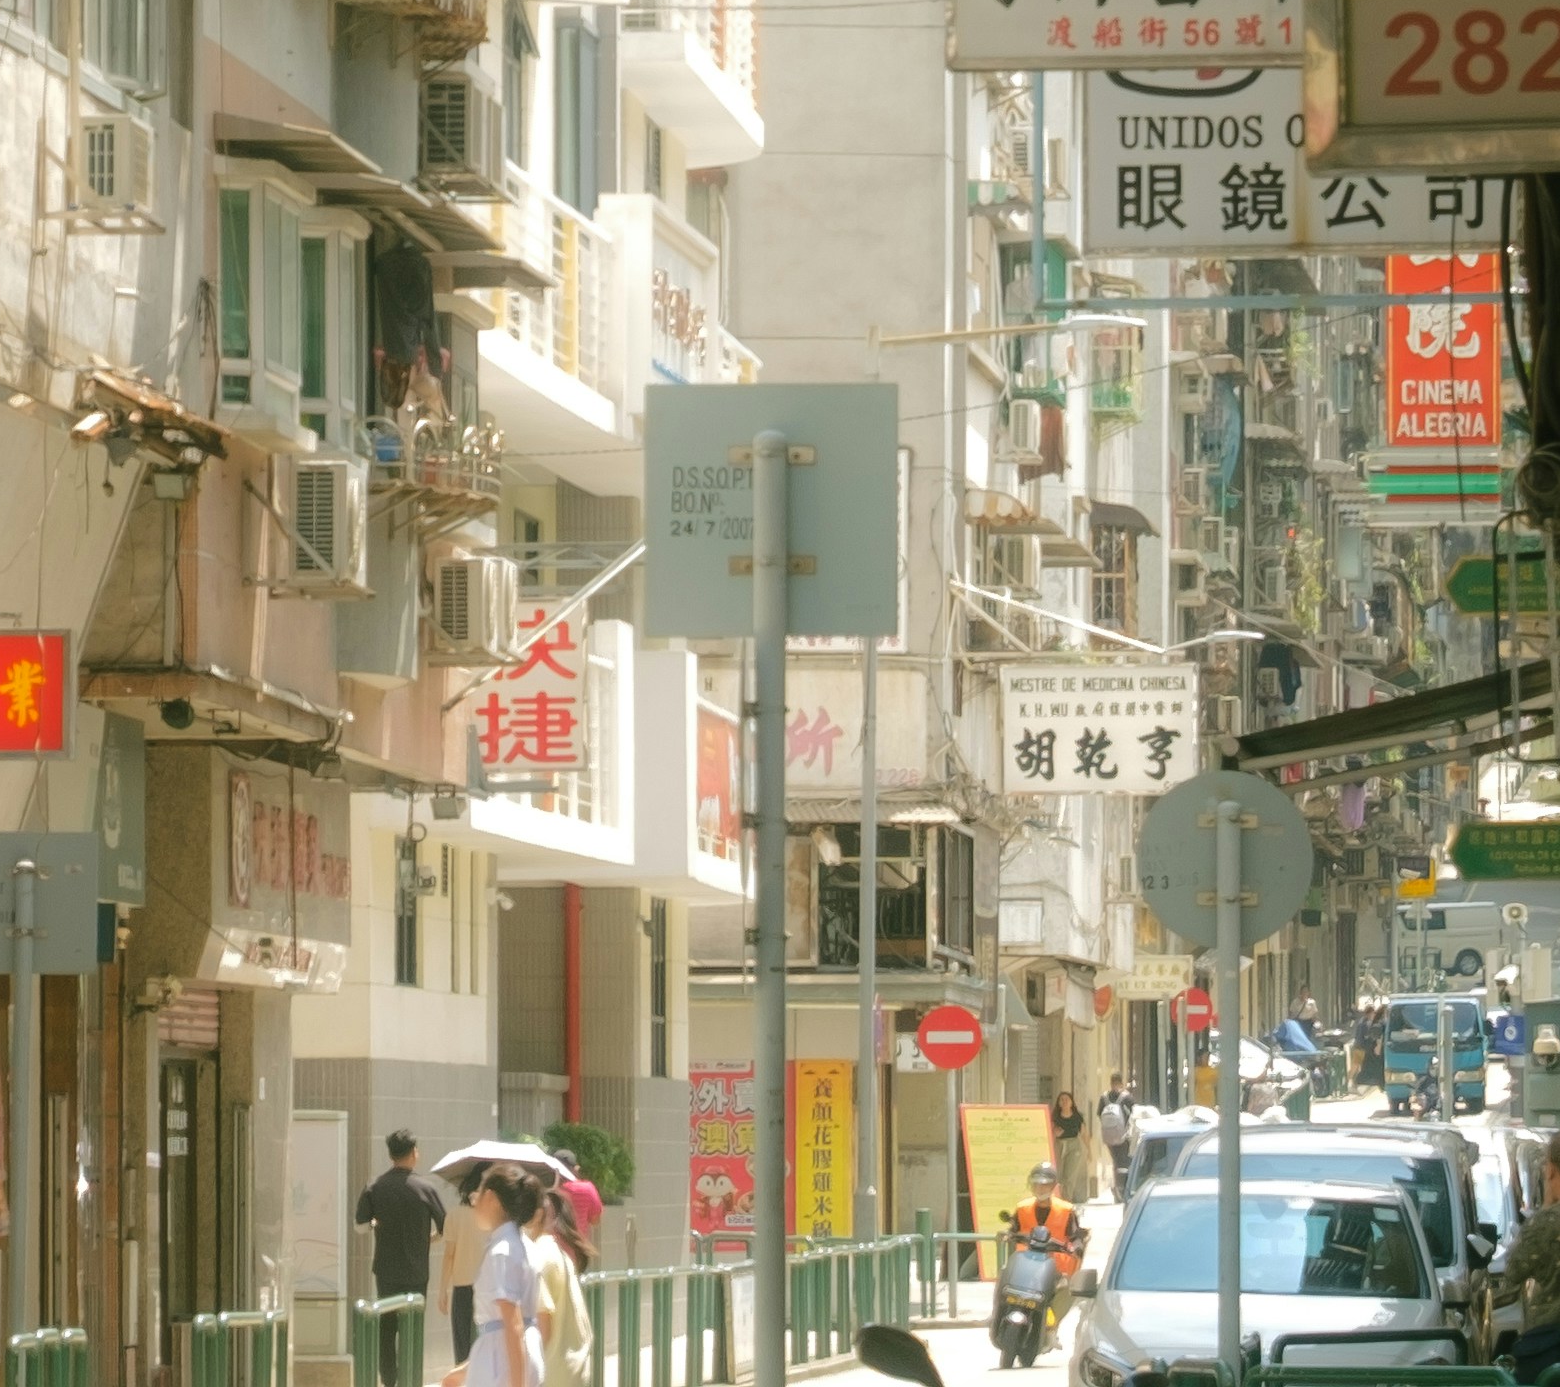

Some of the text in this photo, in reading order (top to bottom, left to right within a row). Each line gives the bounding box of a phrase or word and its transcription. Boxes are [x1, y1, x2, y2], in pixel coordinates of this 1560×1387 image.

[1117, 114, 1264, 151] UNIDOS
[1116, 162, 1486, 232] 眼鏡公司
[1400, 379, 1484, 406] CINEMA
[1395, 412, 1488, 439] ALEGRIA
[1009, 675, 1187, 693] MESTRE DE MEDICINA CHINESA
